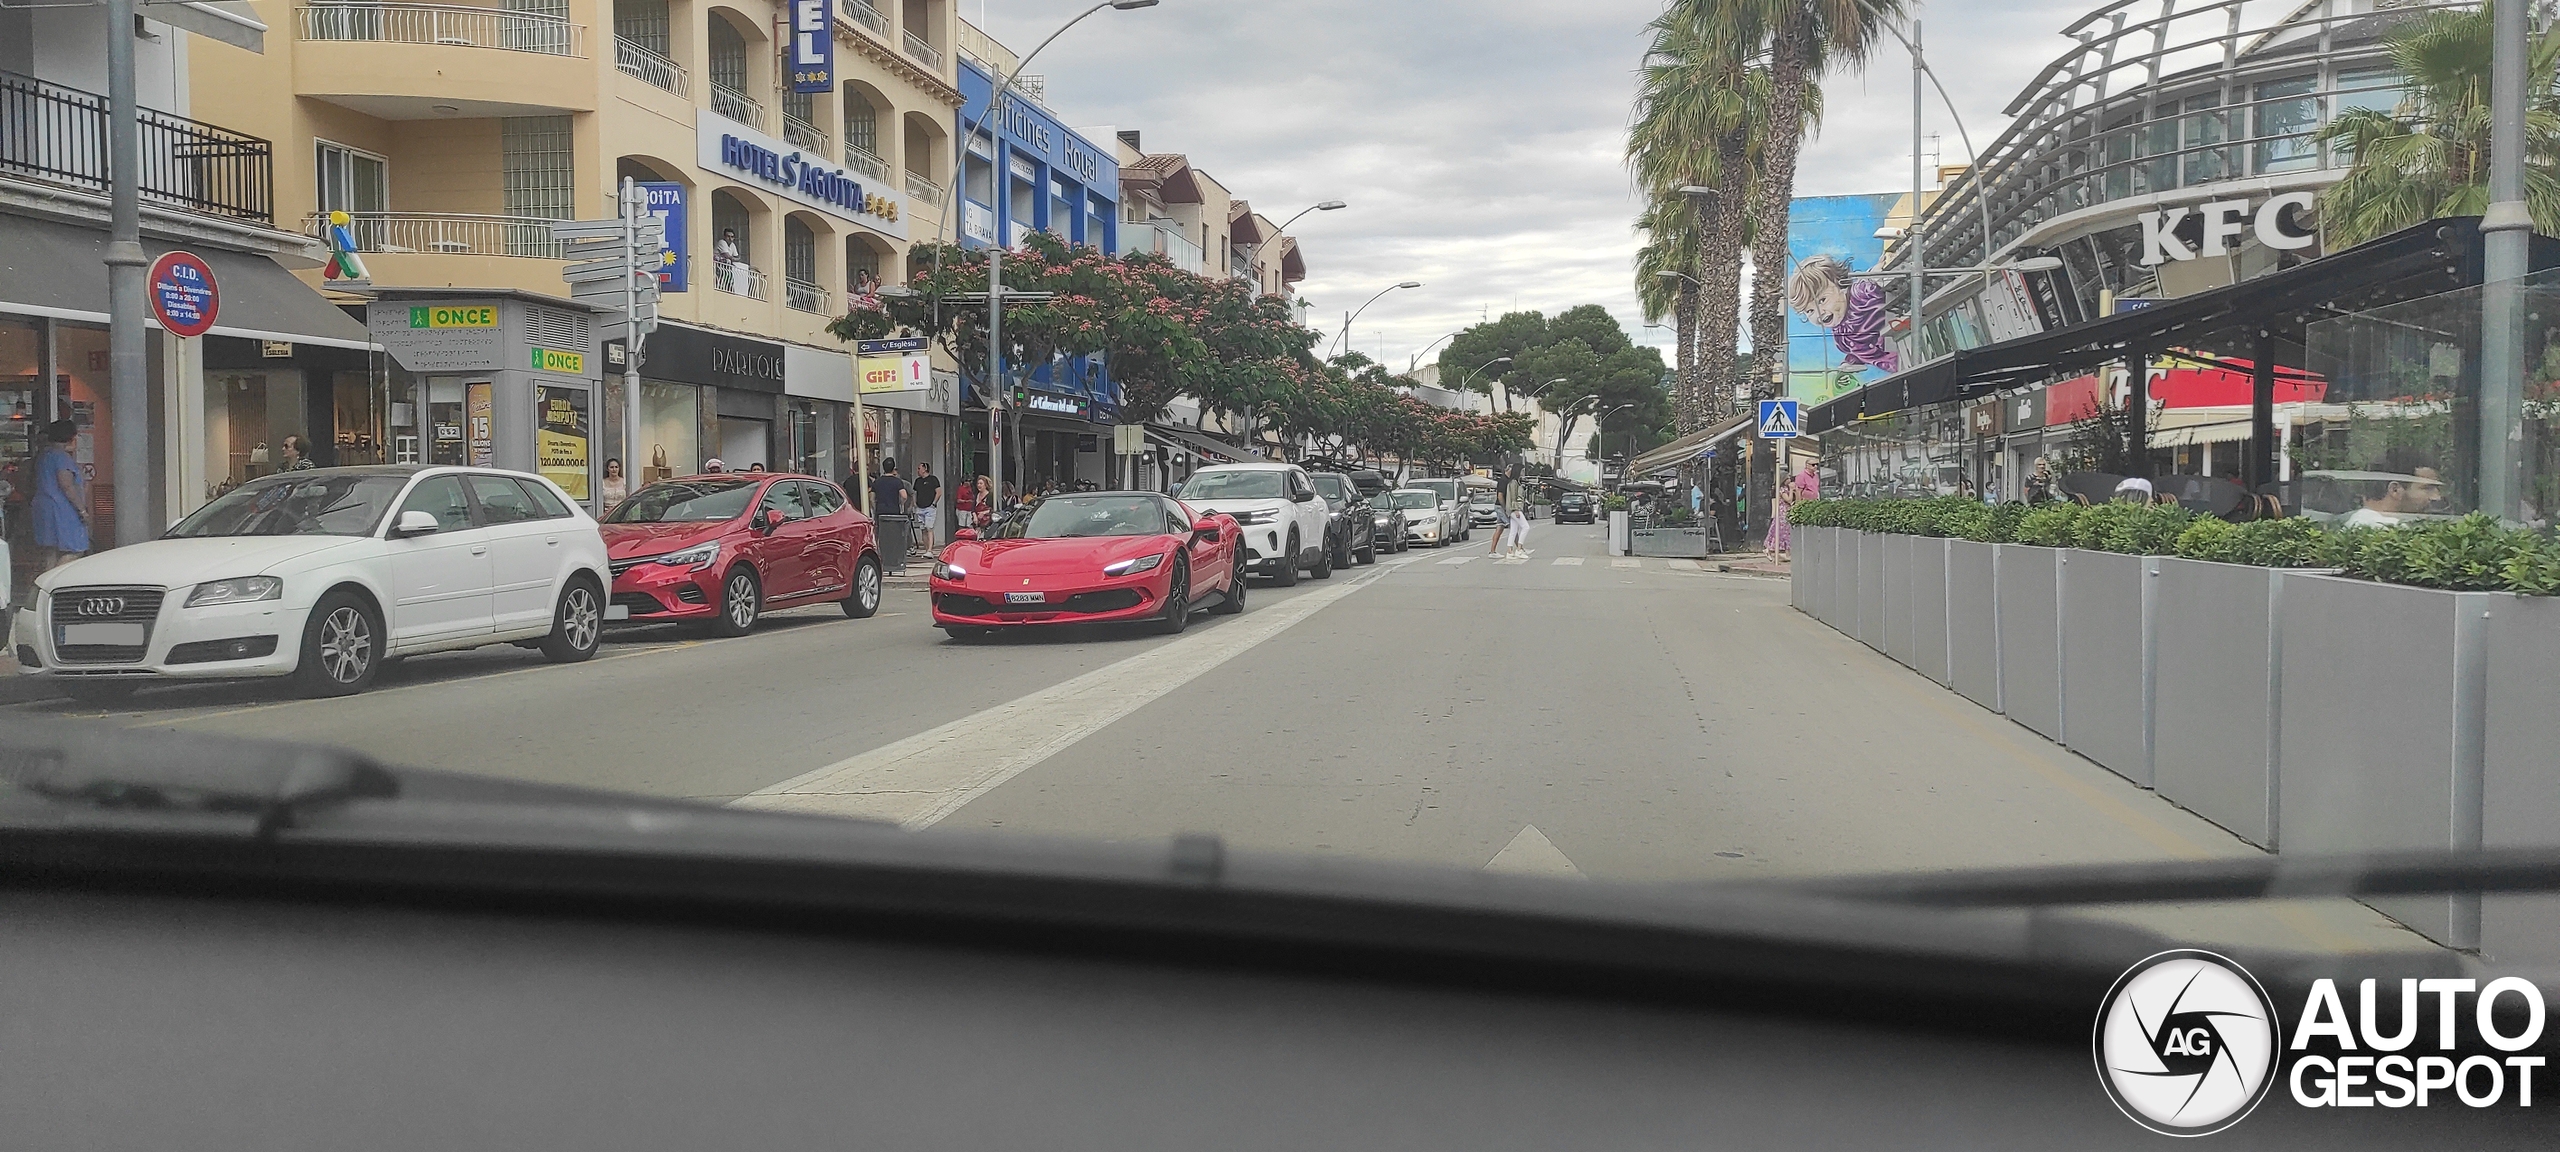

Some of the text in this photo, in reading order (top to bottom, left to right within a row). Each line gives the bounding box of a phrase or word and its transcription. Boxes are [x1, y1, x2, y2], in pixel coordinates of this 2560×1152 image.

[722, 133, 787, 184] HOTEL
[1062, 132, 1097, 183] Royal
[2138, 191, 2313, 266] KFC
[172, 264, 200, 281] C.I.D.
[436, 308, 491, 325] ONCE
[547, 354, 579, 371] ONCE
[712, 346, 784, 380] PARFOIS
[471, 416, 489, 440] 15
